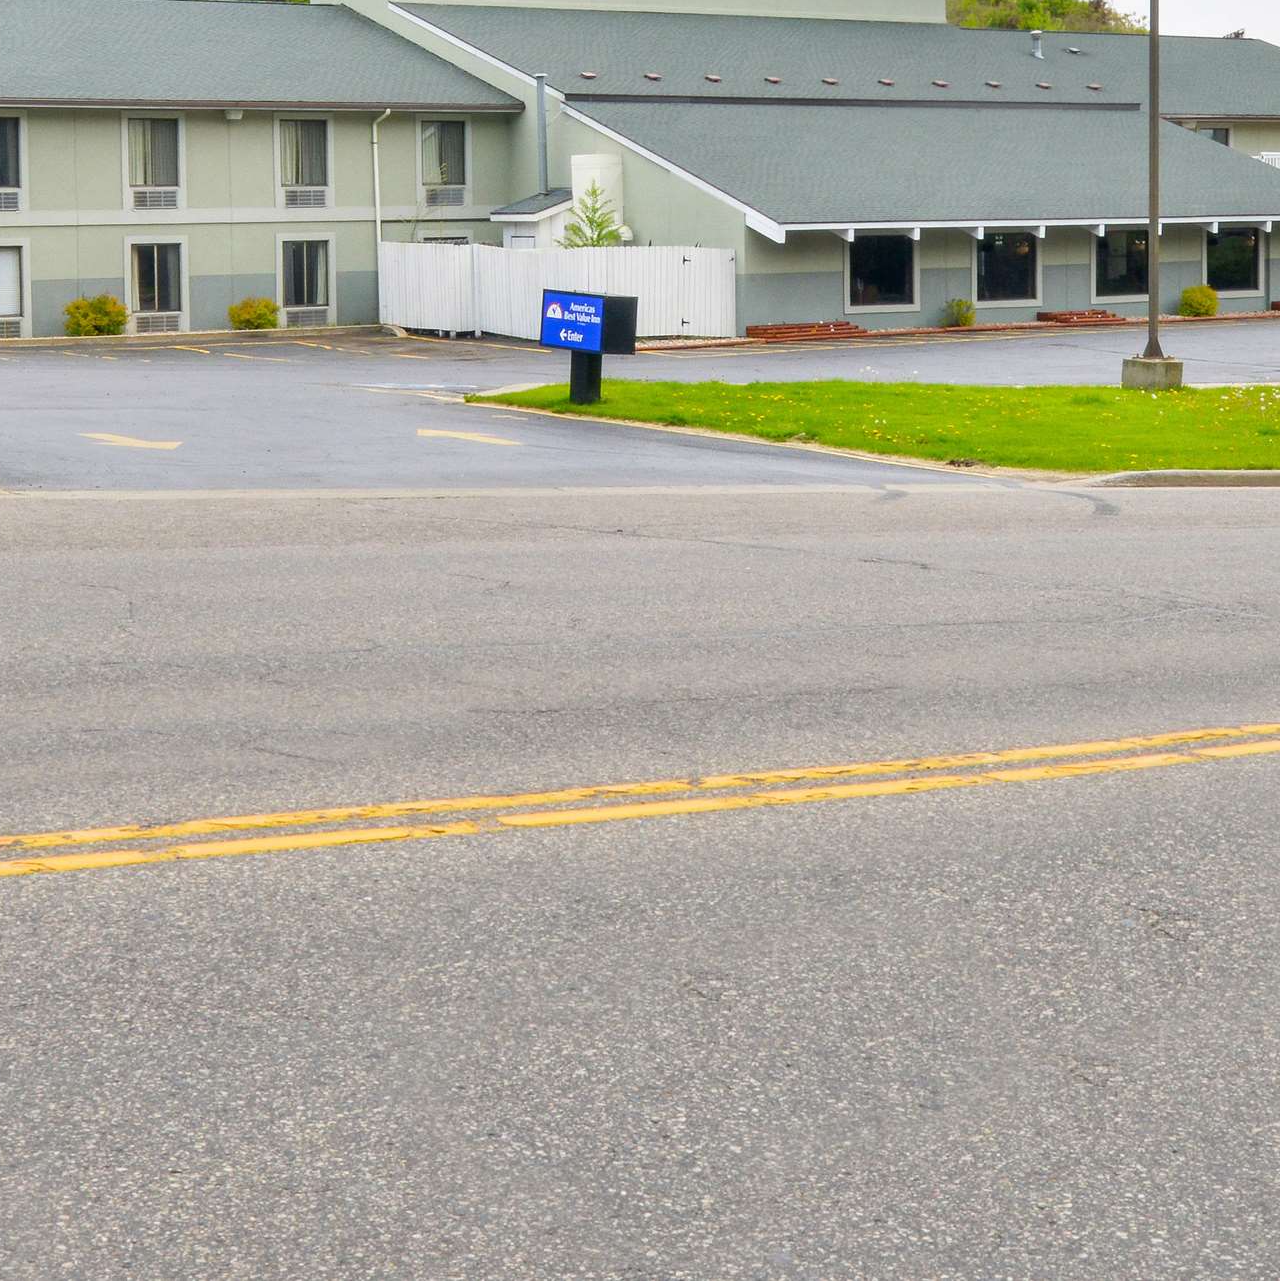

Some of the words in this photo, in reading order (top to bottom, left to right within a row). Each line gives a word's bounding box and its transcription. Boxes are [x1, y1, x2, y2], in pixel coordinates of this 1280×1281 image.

[570, 302, 595, 313] Americas
[564, 311, 575, 320] Best
[576, 312, 590, 322] Value
[591, 314, 600, 323] Inn
[568, 330, 583, 342] Enter
